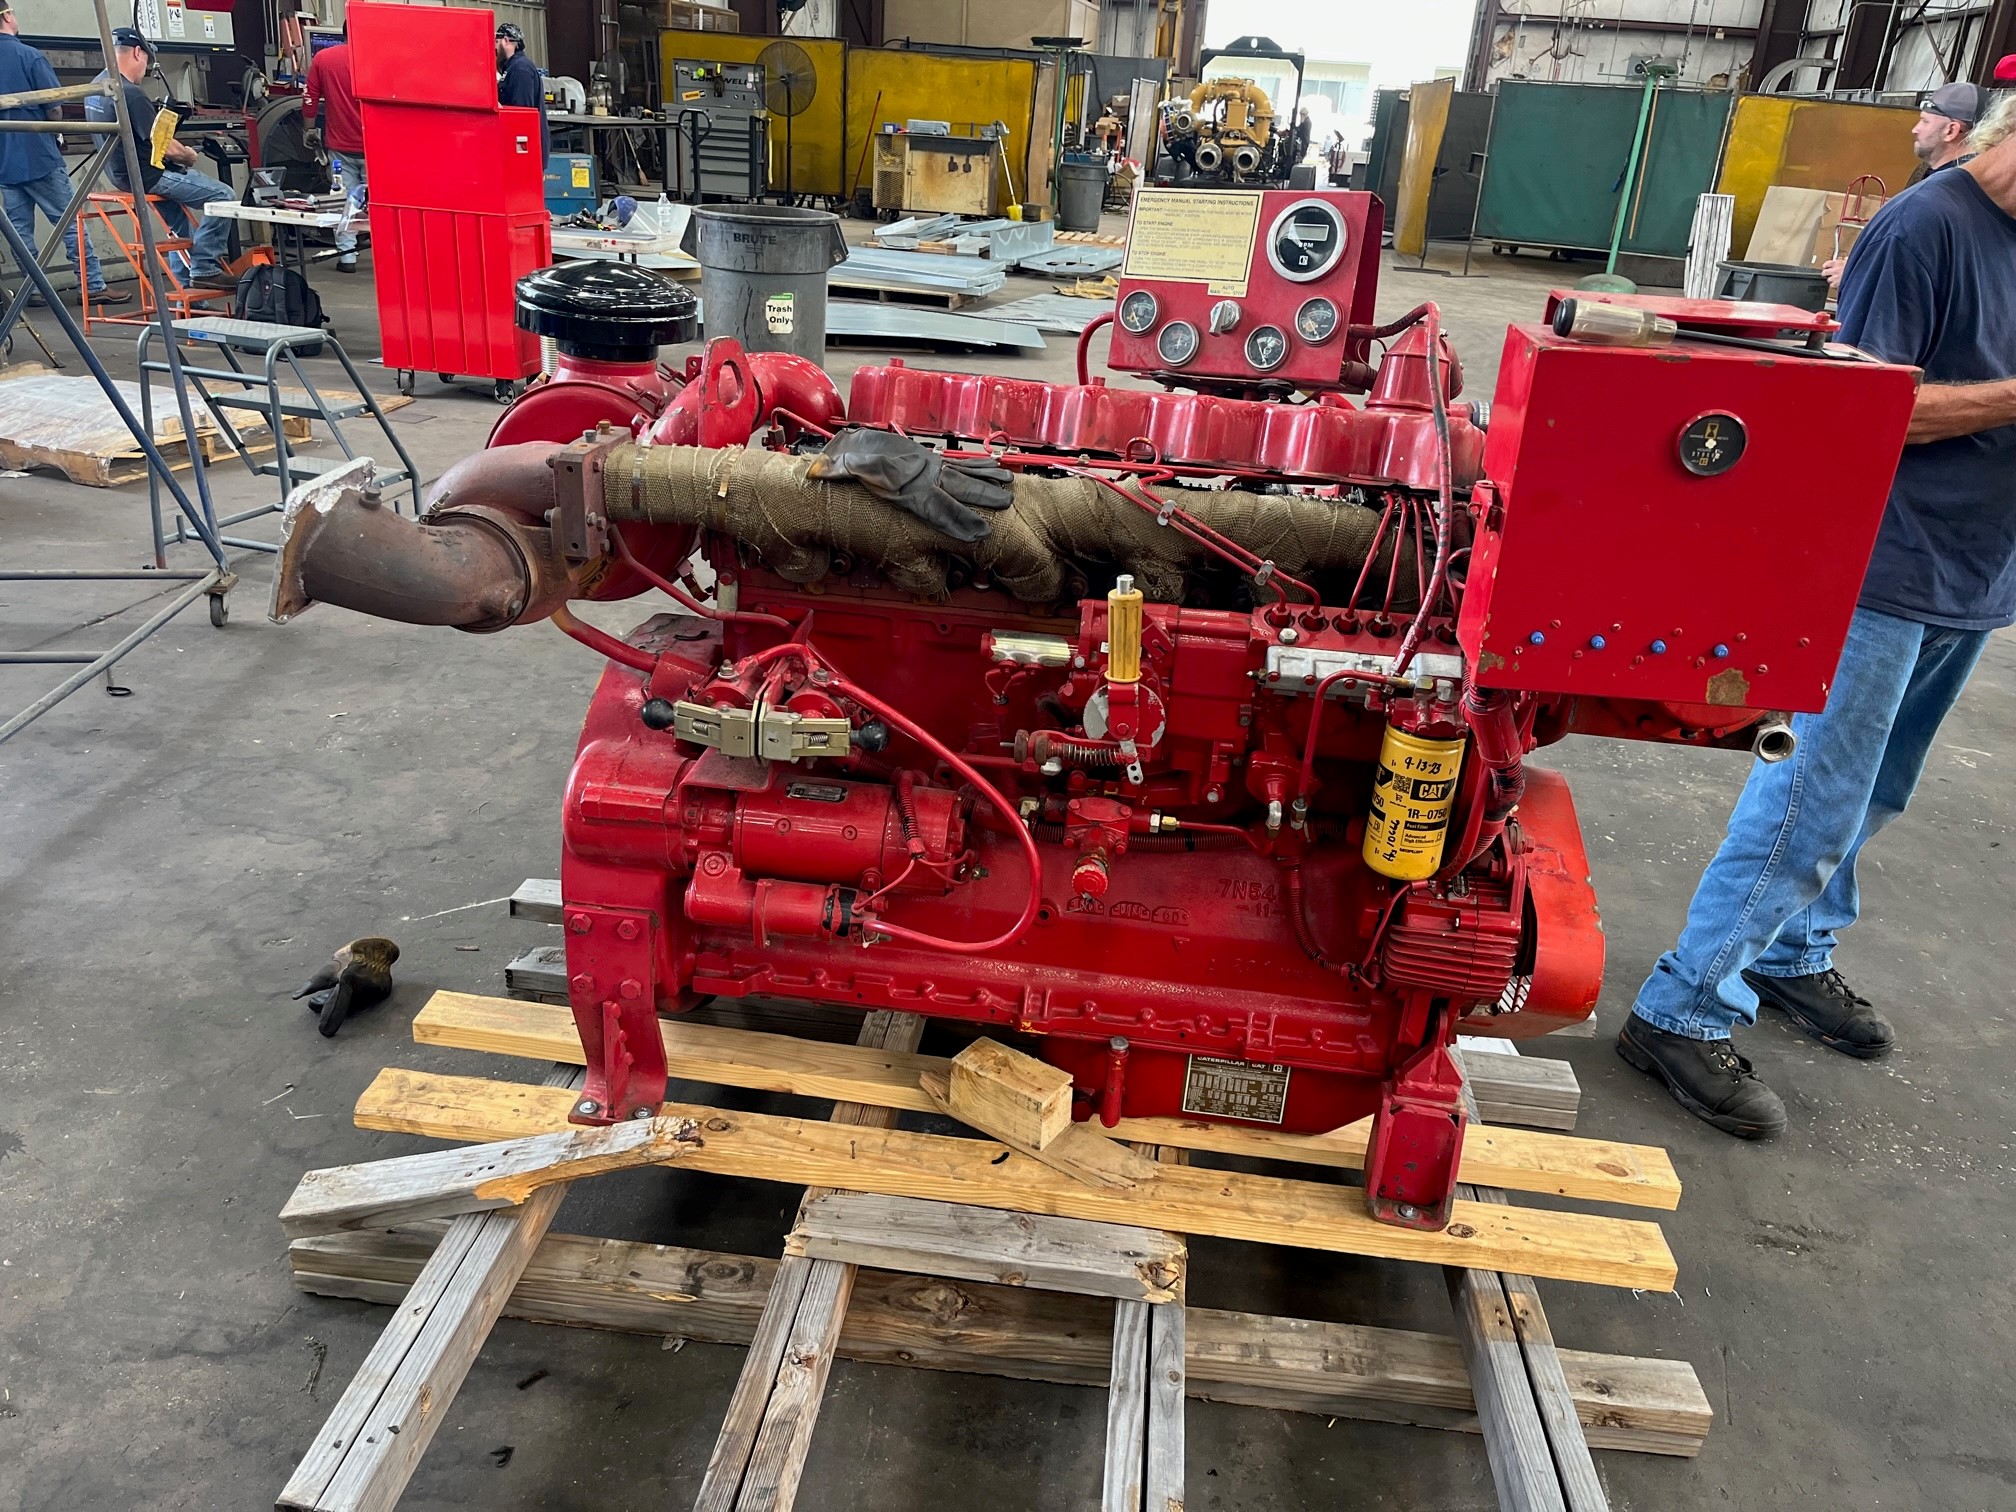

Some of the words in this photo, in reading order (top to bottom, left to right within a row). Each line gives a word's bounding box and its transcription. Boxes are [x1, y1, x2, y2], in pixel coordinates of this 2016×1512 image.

[733, 232, 777, 246] BRUTE
[767, 304, 792, 313] Trash
[769, 316, 790, 325] Only
[1404, 756, 1443, 775] 9-13-23
[1419, 783, 1445, 799] CAT
[1407, 808, 1448, 819] 1R-0750
[1197, 1056, 1245, 1066] CATERPILLAR
